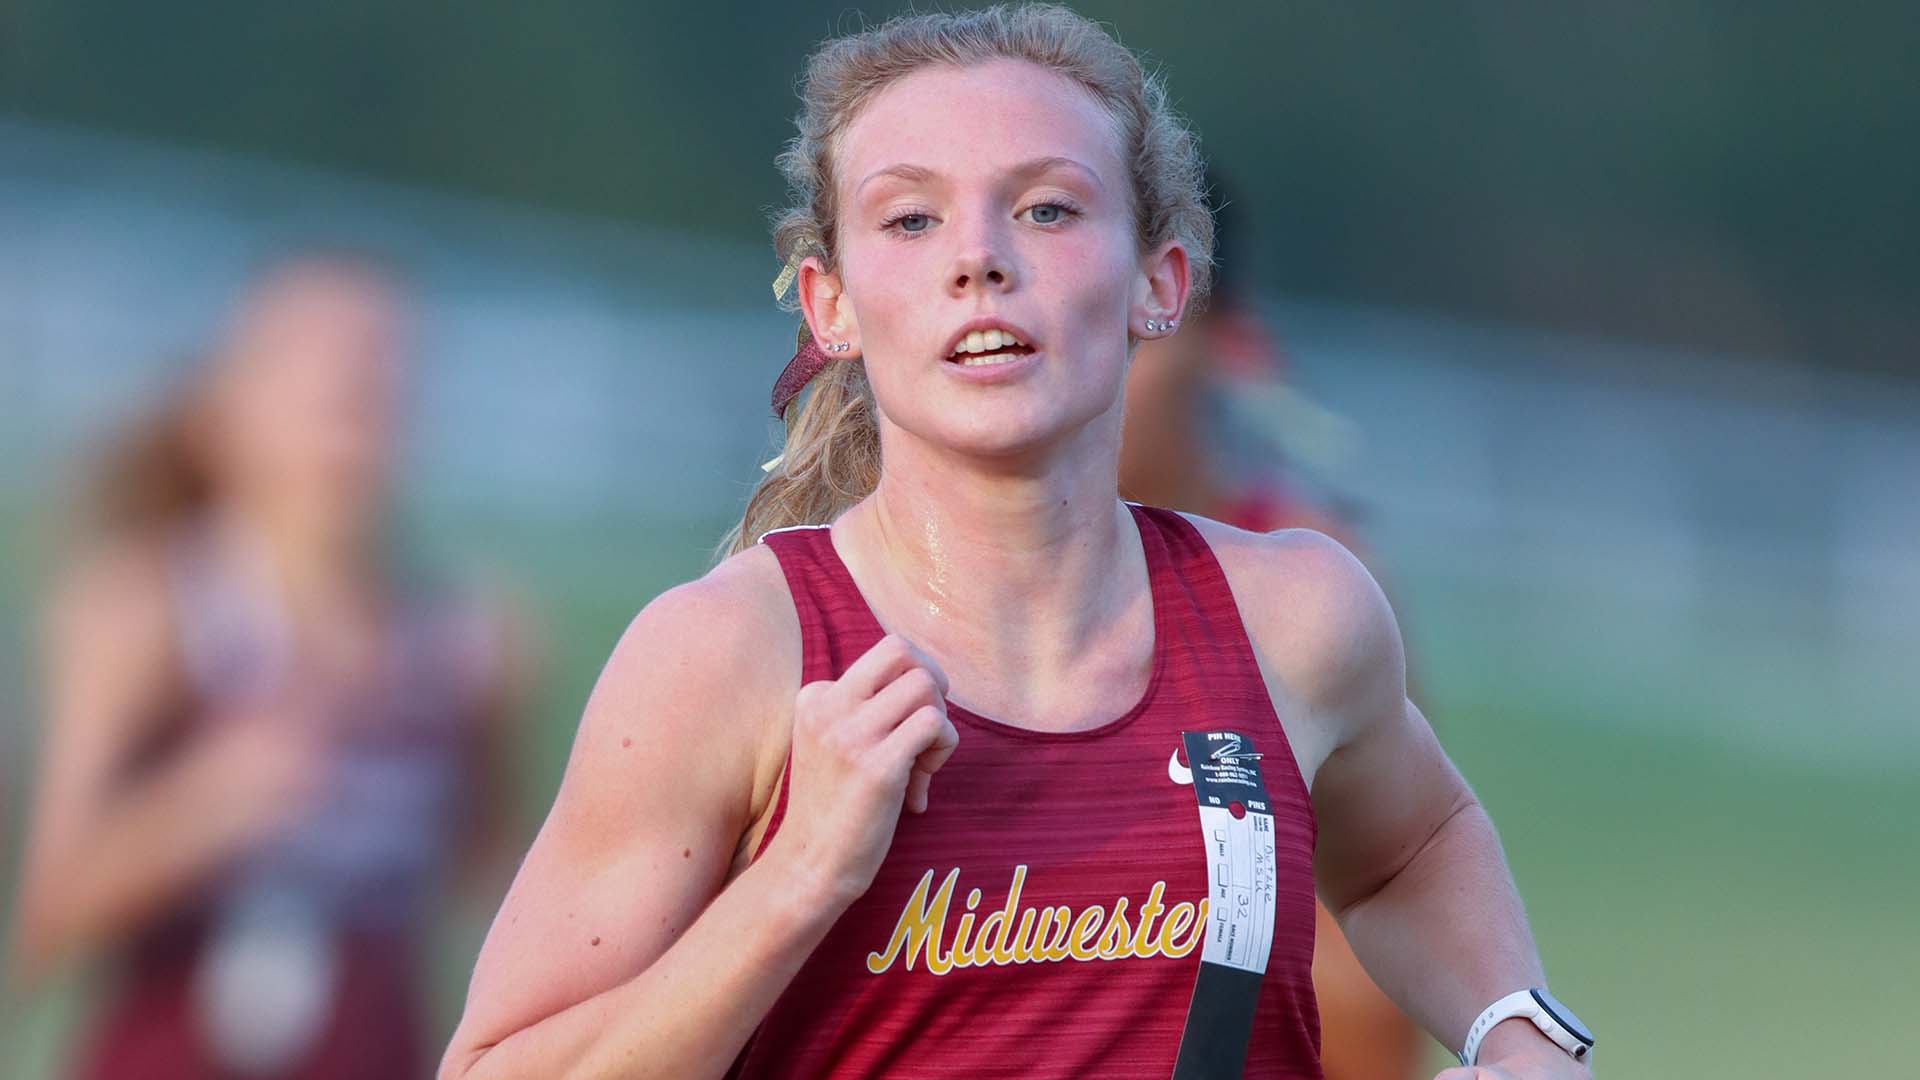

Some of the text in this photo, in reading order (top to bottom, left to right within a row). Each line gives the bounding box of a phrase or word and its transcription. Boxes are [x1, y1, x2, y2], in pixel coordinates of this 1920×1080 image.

[1207, 732, 1222, 741] PIN
[1220, 757, 1239, 765] ONLY
[1208, 795, 1266, 811] NO PINS
[1236, 894, 1249, 919] 32
